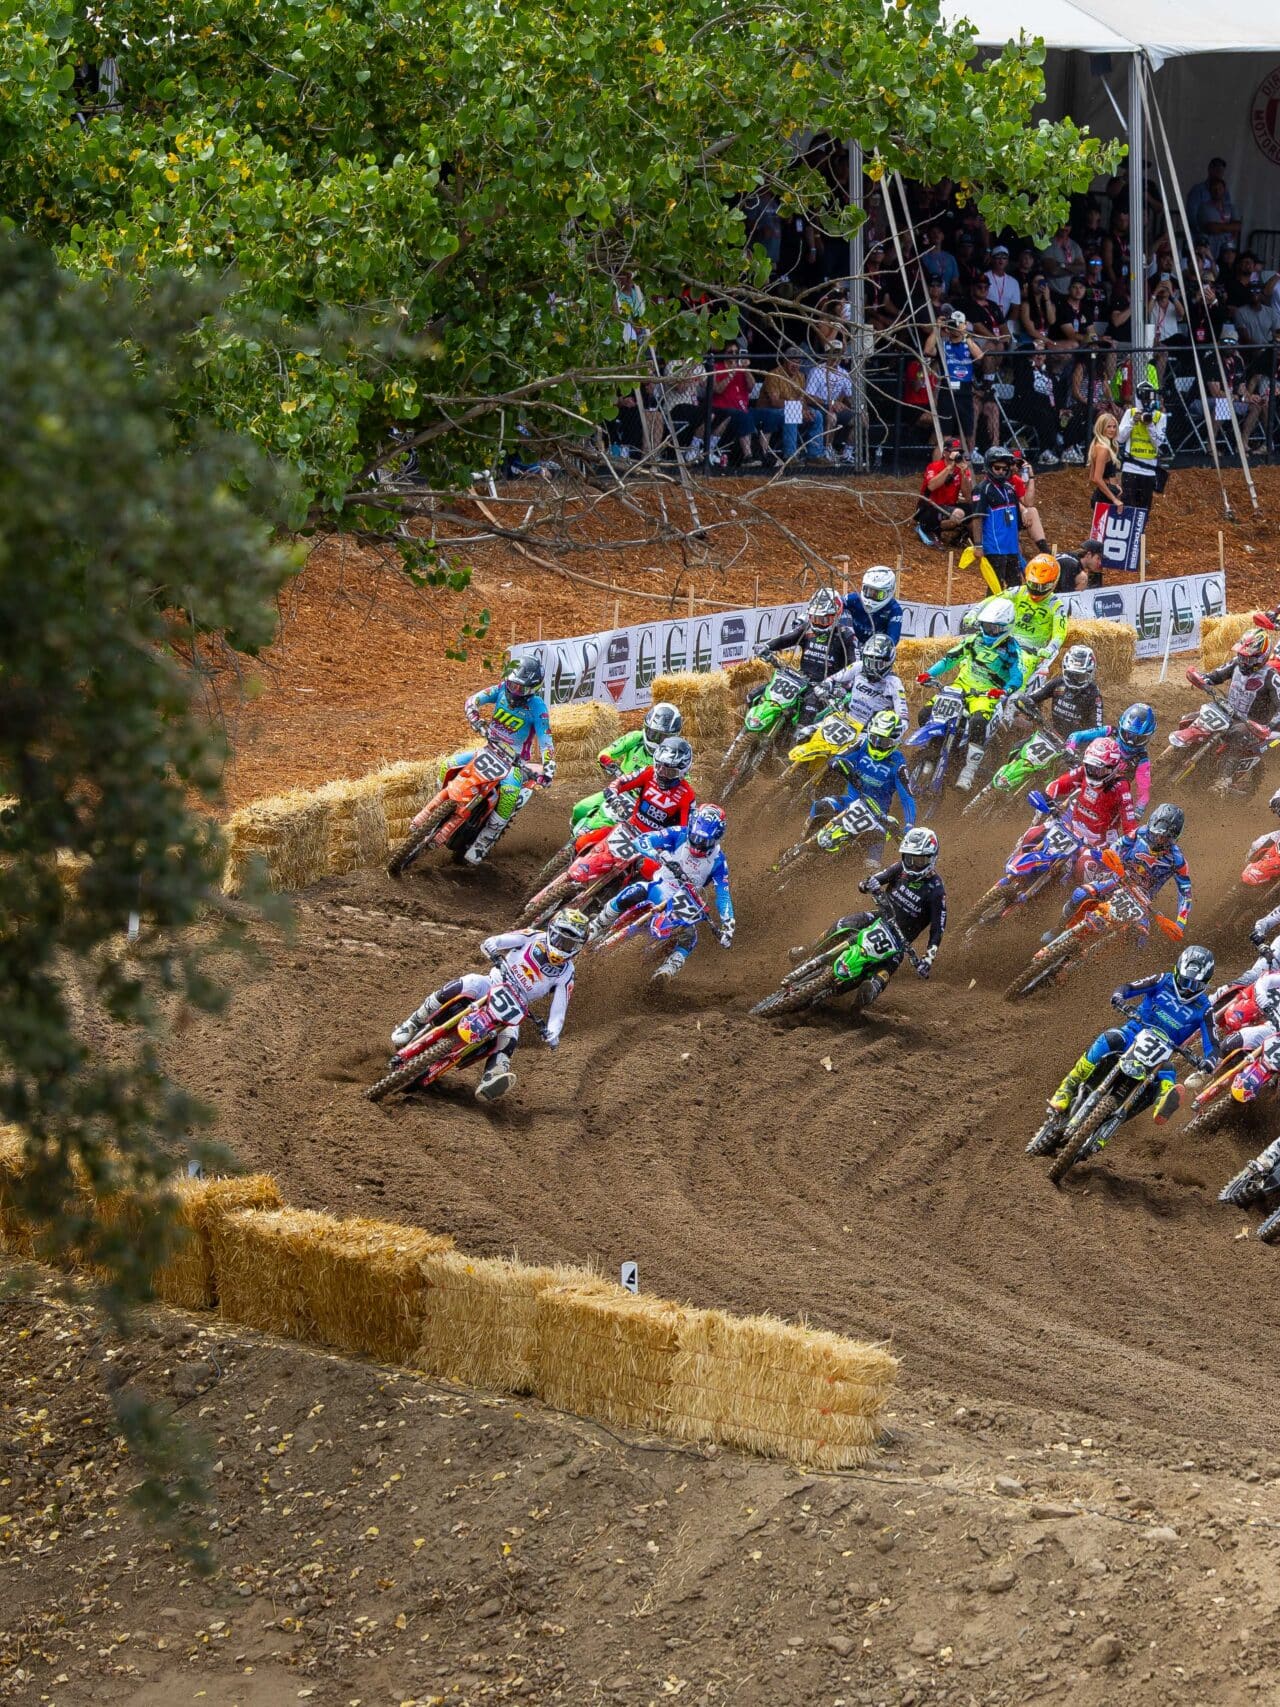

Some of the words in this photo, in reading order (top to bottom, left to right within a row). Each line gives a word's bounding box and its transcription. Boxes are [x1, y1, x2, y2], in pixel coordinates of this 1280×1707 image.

[1202, 709, 1226, 729] 50
[823, 720, 851, 745] 45
[474, 753, 505, 781] 62
[859, 757, 890, 777] FXR
[644, 786, 678, 809] FLY
[846, 805, 873, 834] 20
[867, 929, 892, 954] 69
[511, 964, 522, 978] Red
[520, 976, 533, 992] Bull
[490, 989, 521, 1023] 51
[1135, 1037, 1168, 1064] 31
